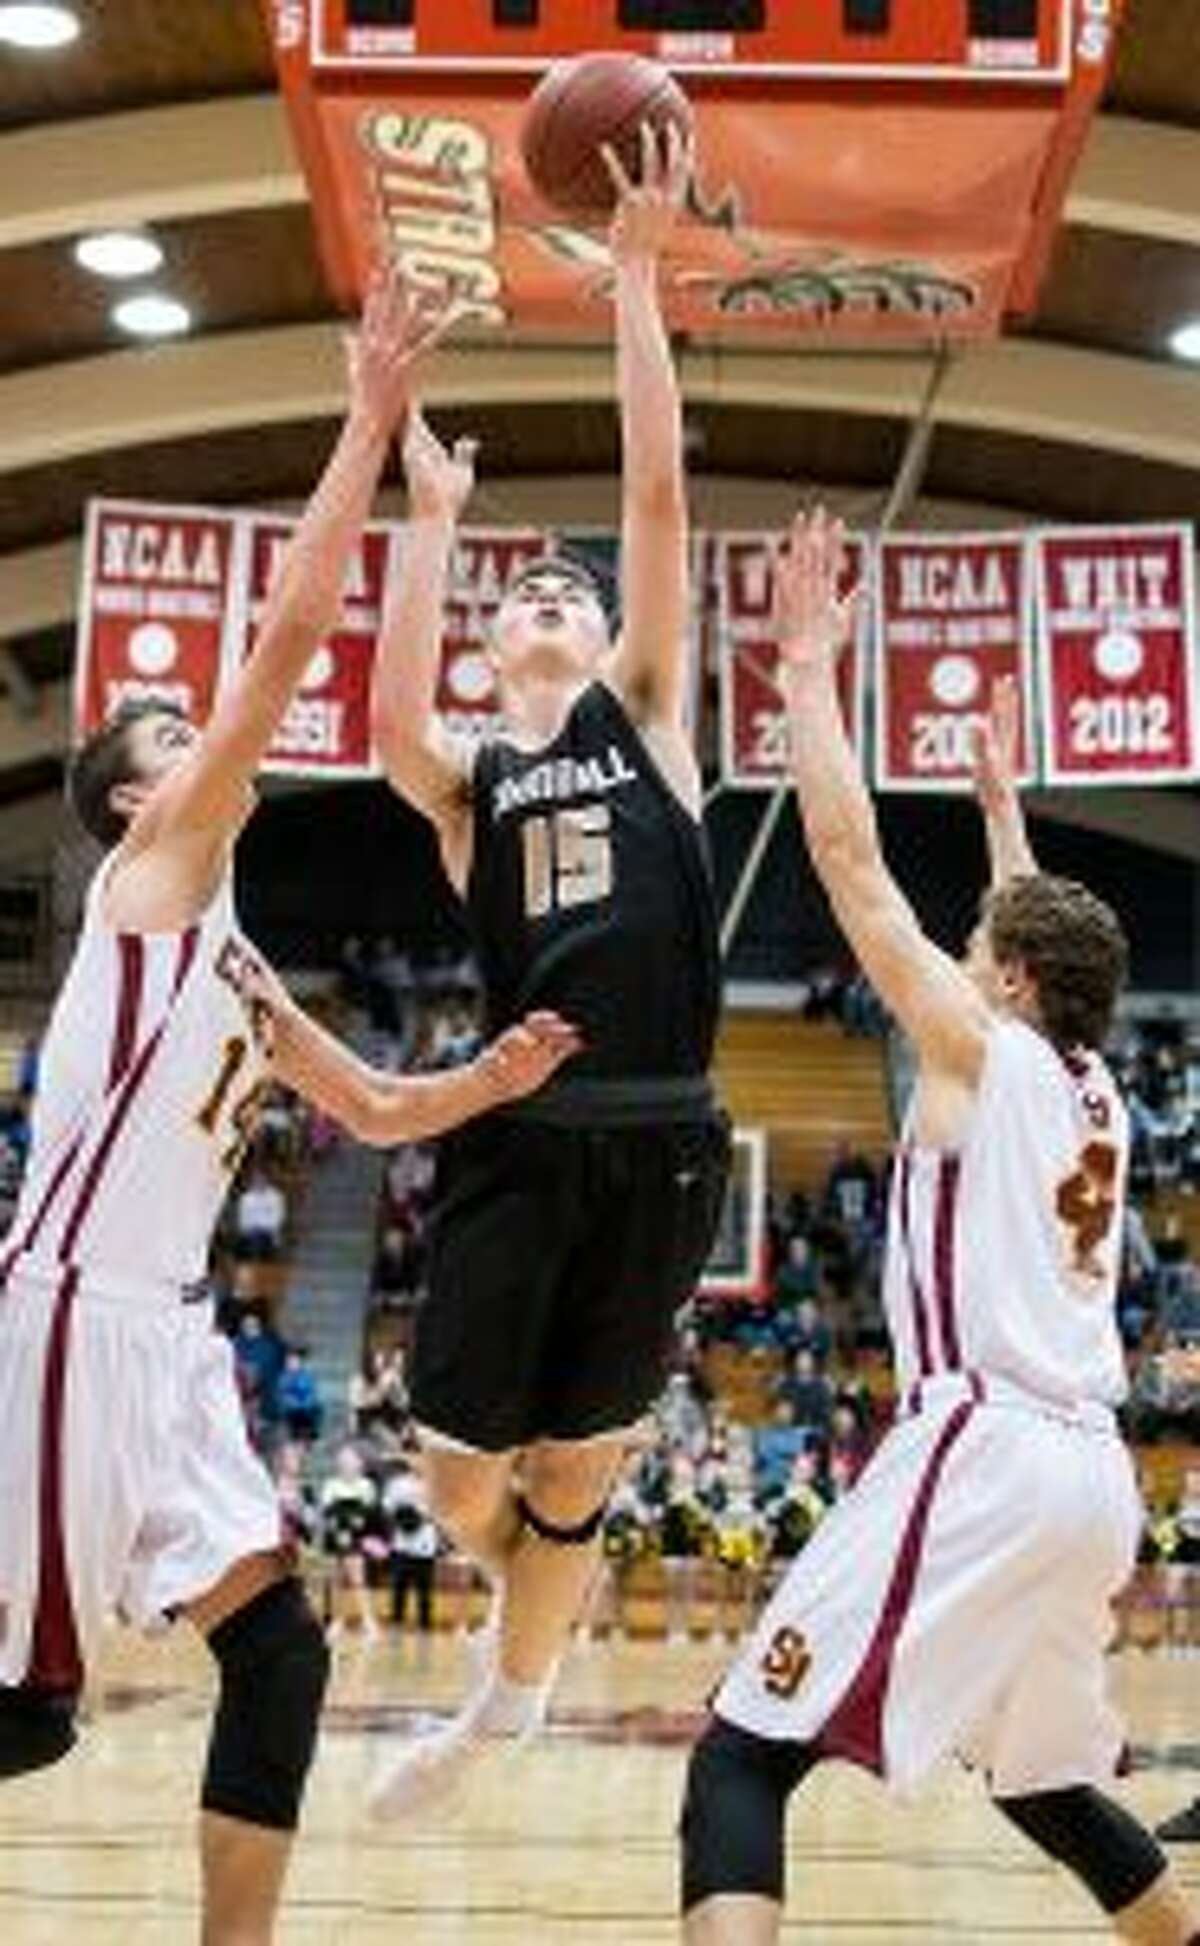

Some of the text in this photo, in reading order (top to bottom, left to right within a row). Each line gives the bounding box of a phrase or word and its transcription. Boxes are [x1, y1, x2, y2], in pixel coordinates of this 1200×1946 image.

[103, 525, 222, 584] NCAA
[900, 554, 1008, 609] NCAA
[1069, 695, 1173, 753] 2012
[521, 804, 612, 918] 15
